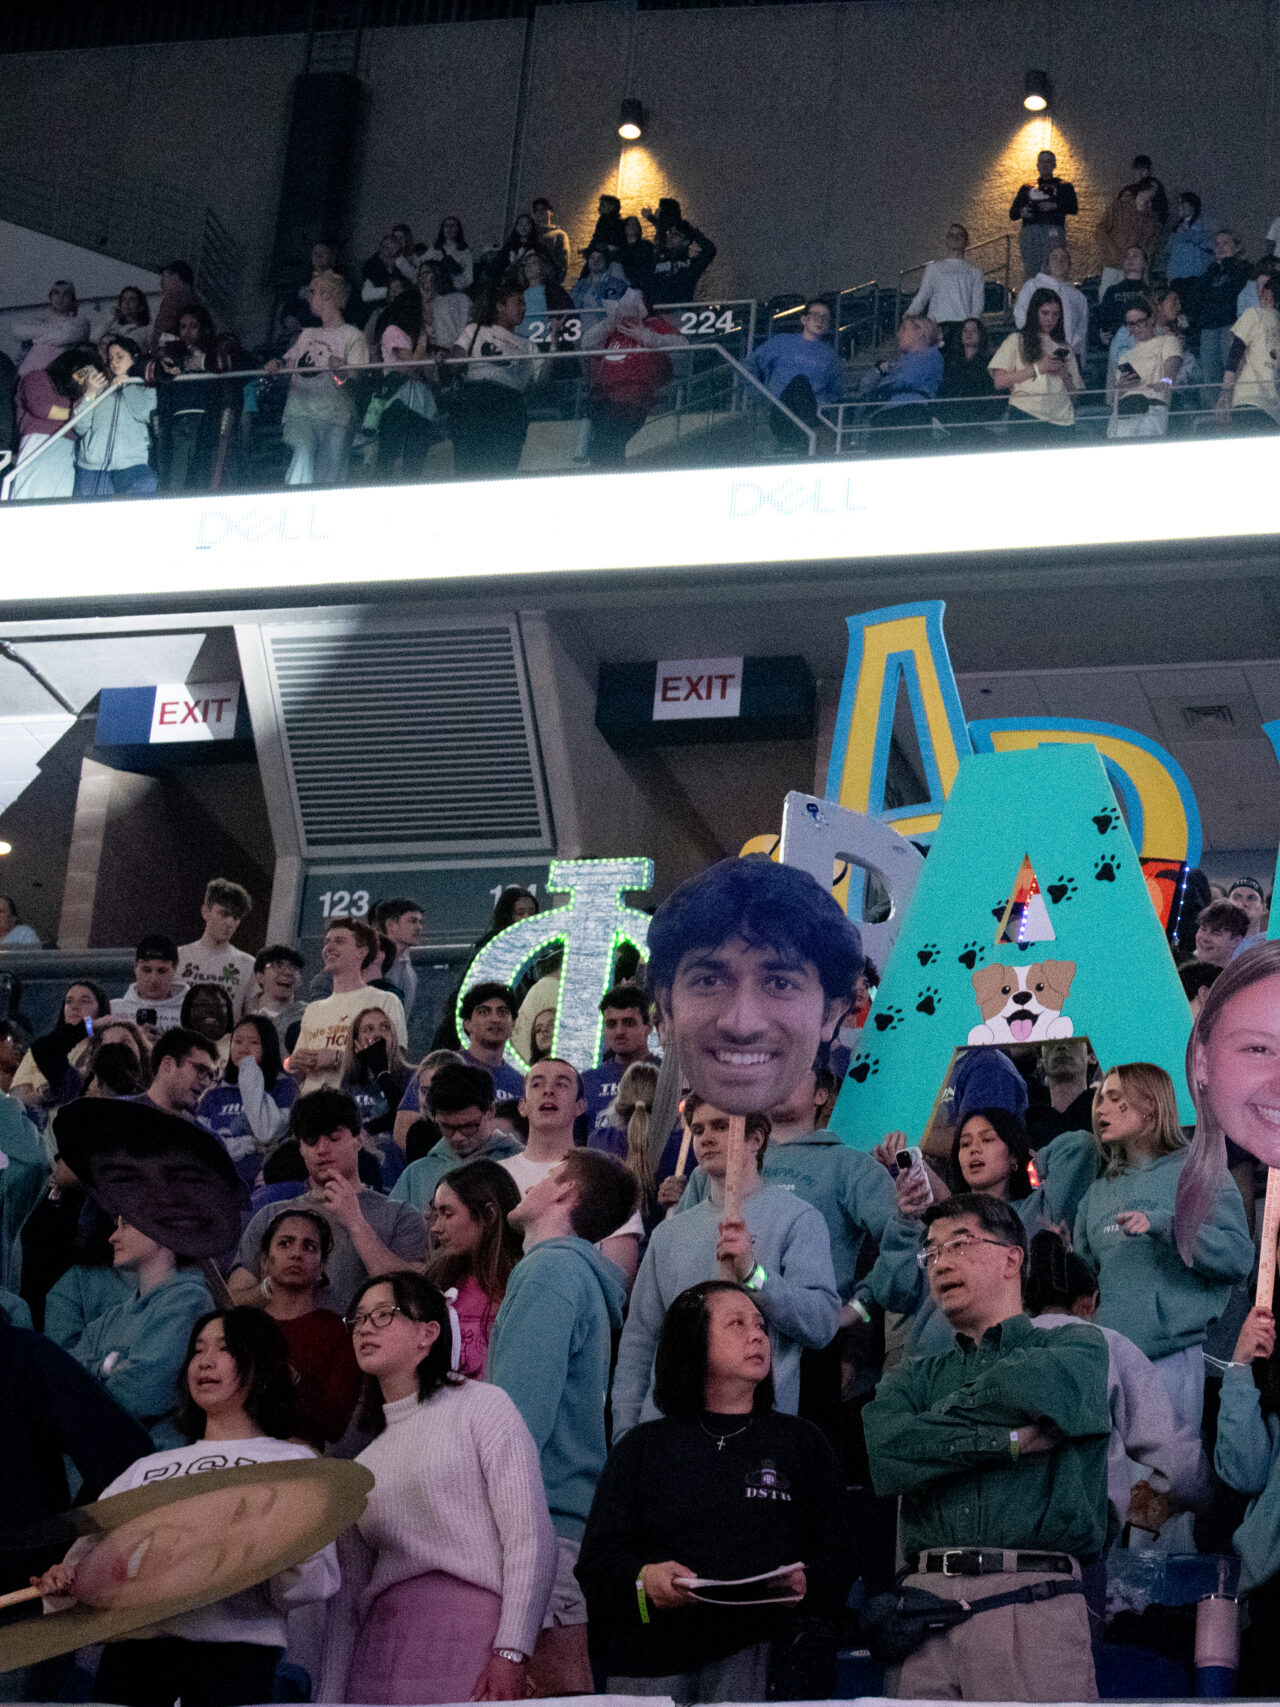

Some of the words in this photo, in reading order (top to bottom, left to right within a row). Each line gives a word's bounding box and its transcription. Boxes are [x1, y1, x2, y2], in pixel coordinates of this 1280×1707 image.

[528, 318, 582, 343] 23
[680, 310, 735, 335] 224
[726, 475, 867, 519] DELL
[196, 503, 331, 549] DELL
[661, 674, 736, 702] EXIT
[159, 698, 231, 725] EXIT
[319, 889, 370, 917] 123
